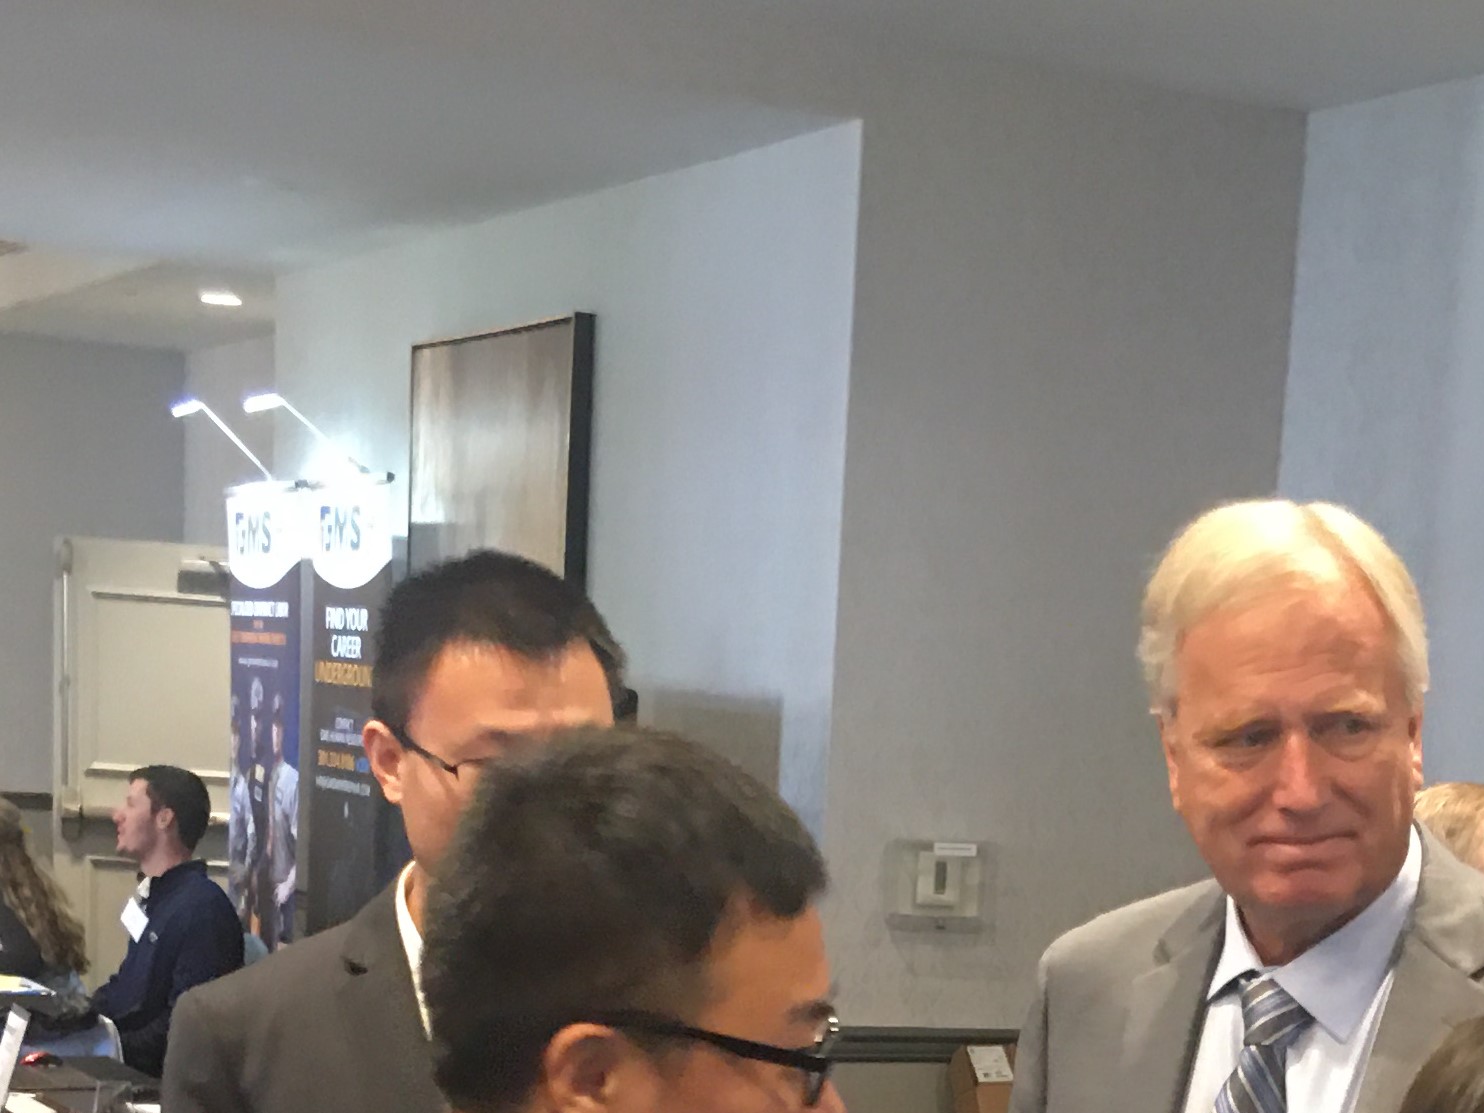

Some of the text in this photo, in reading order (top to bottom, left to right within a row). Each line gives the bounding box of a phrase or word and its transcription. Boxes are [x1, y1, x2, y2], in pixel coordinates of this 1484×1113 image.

[325, 606, 368, 631] FIND YOUR
[331, 634, 362, 659] CAREER
[315, 660, 374, 687] UNDERGROUN
